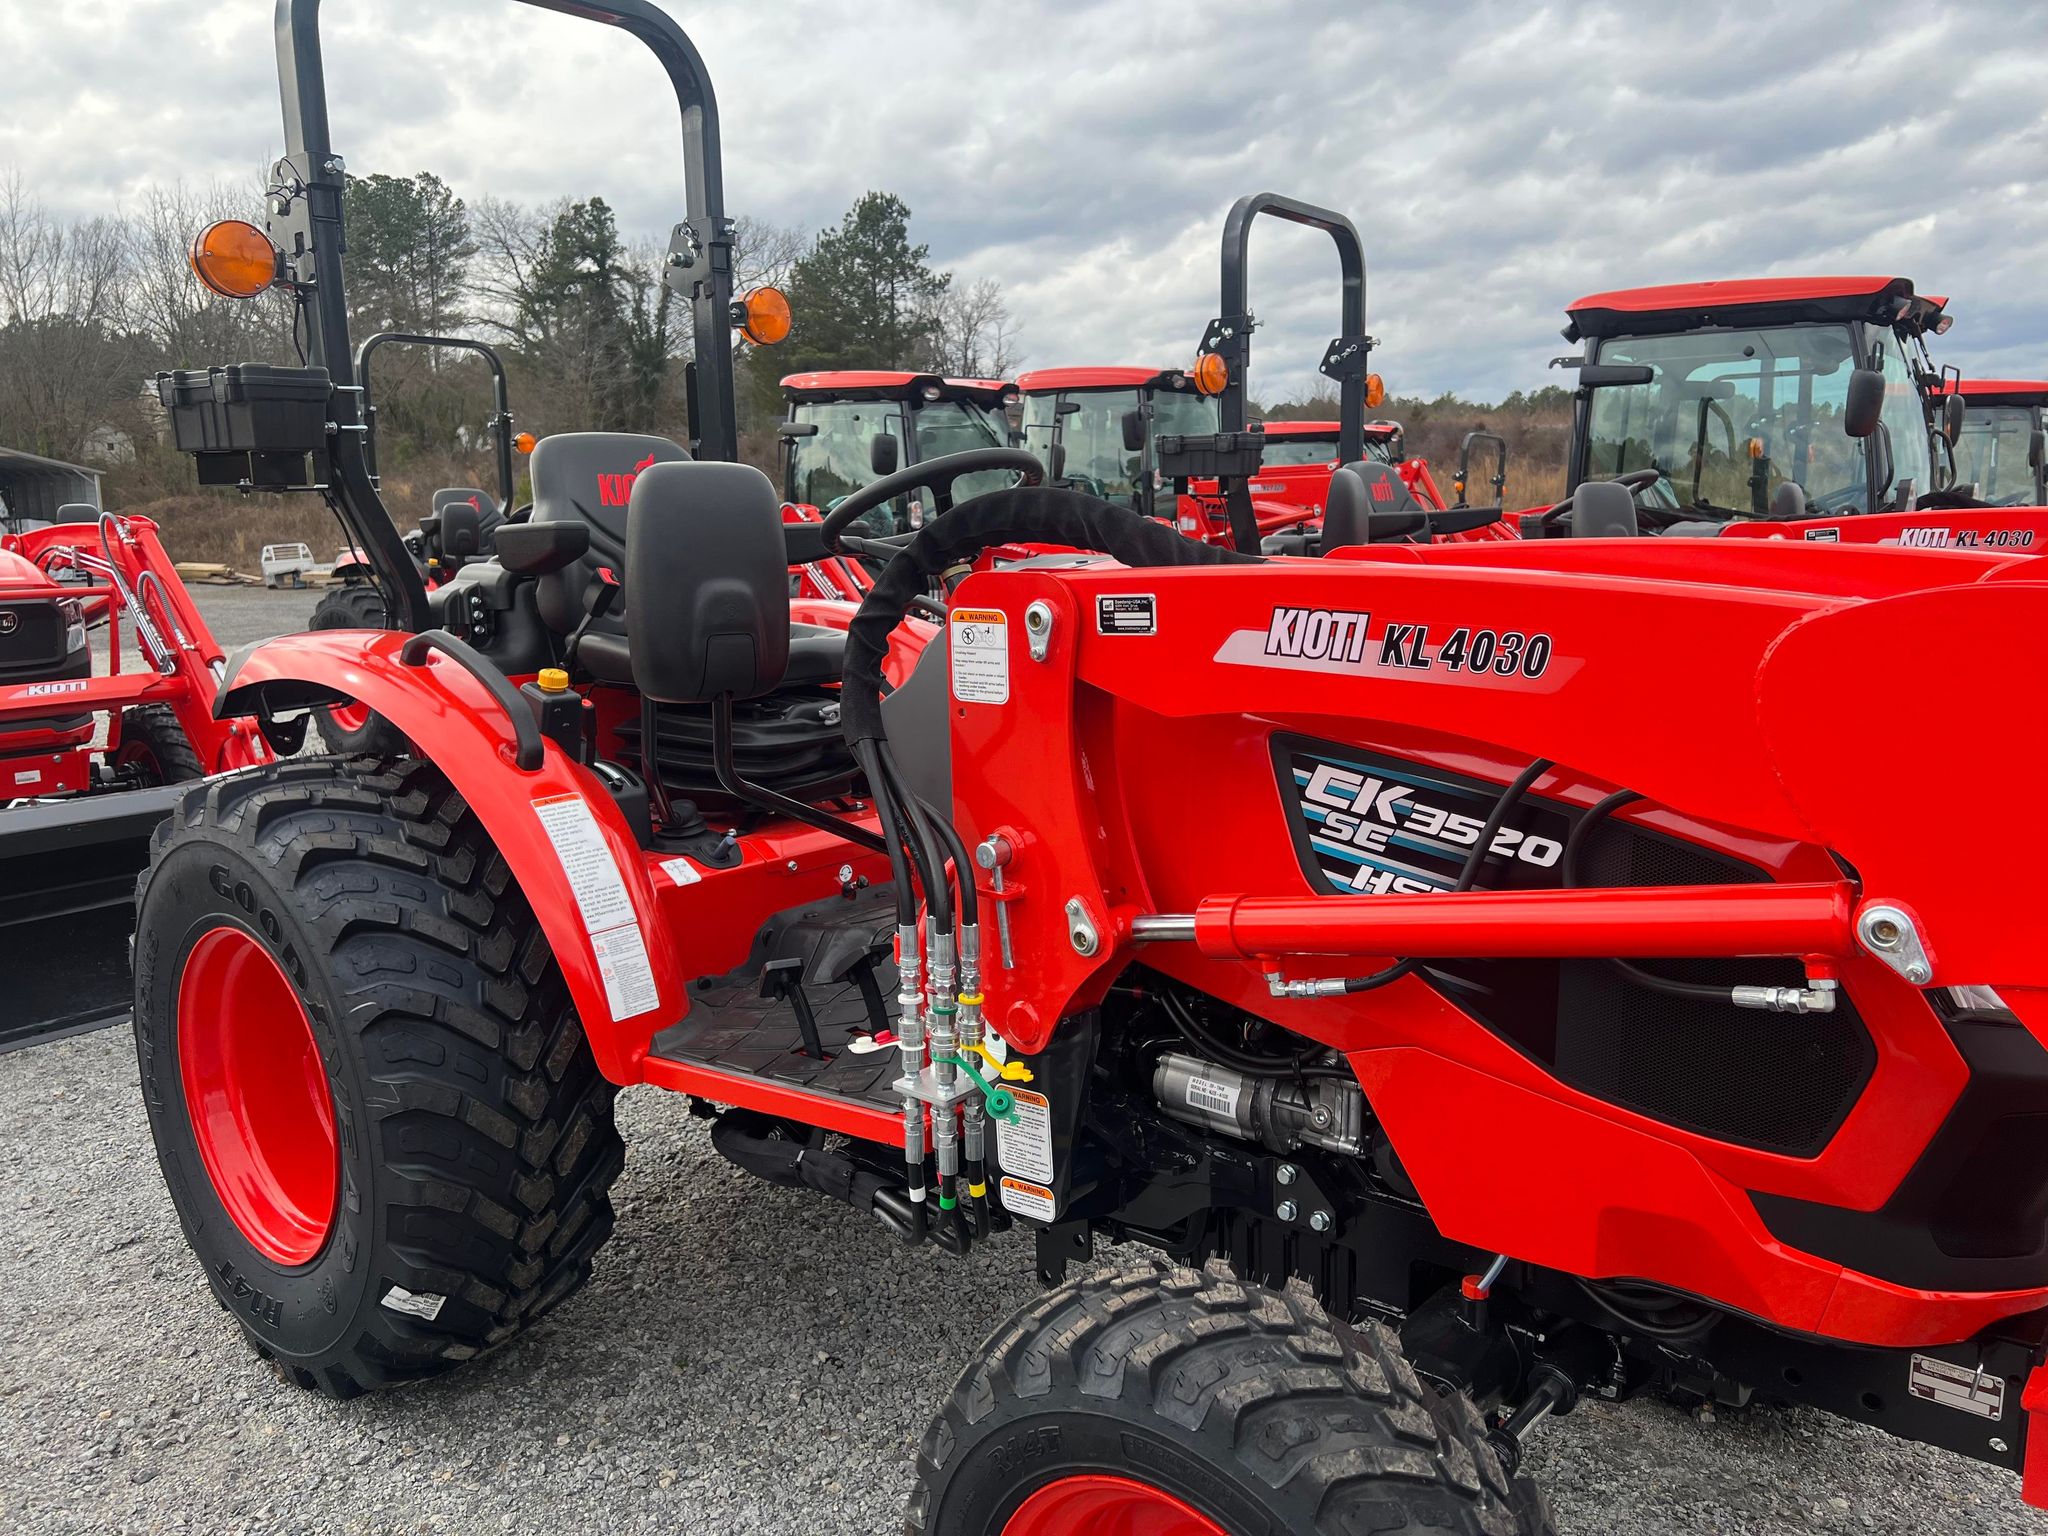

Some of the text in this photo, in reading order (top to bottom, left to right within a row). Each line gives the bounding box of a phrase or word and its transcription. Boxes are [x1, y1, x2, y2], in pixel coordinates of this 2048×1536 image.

[597, 473, 637, 506] KIO
[1898, 528, 2034, 548] KIOTI KL 4030
[968, 613, 998, 621] WARNING
[1264, 605, 1553, 679] KIOTI KL 4030
[27, 681, 88, 696] KIOTI
[1319, 811, 1396, 852] SE
[1013, 1091, 1041, 1104] WARNING
[1018, 1183, 1046, 1197] WARNING
